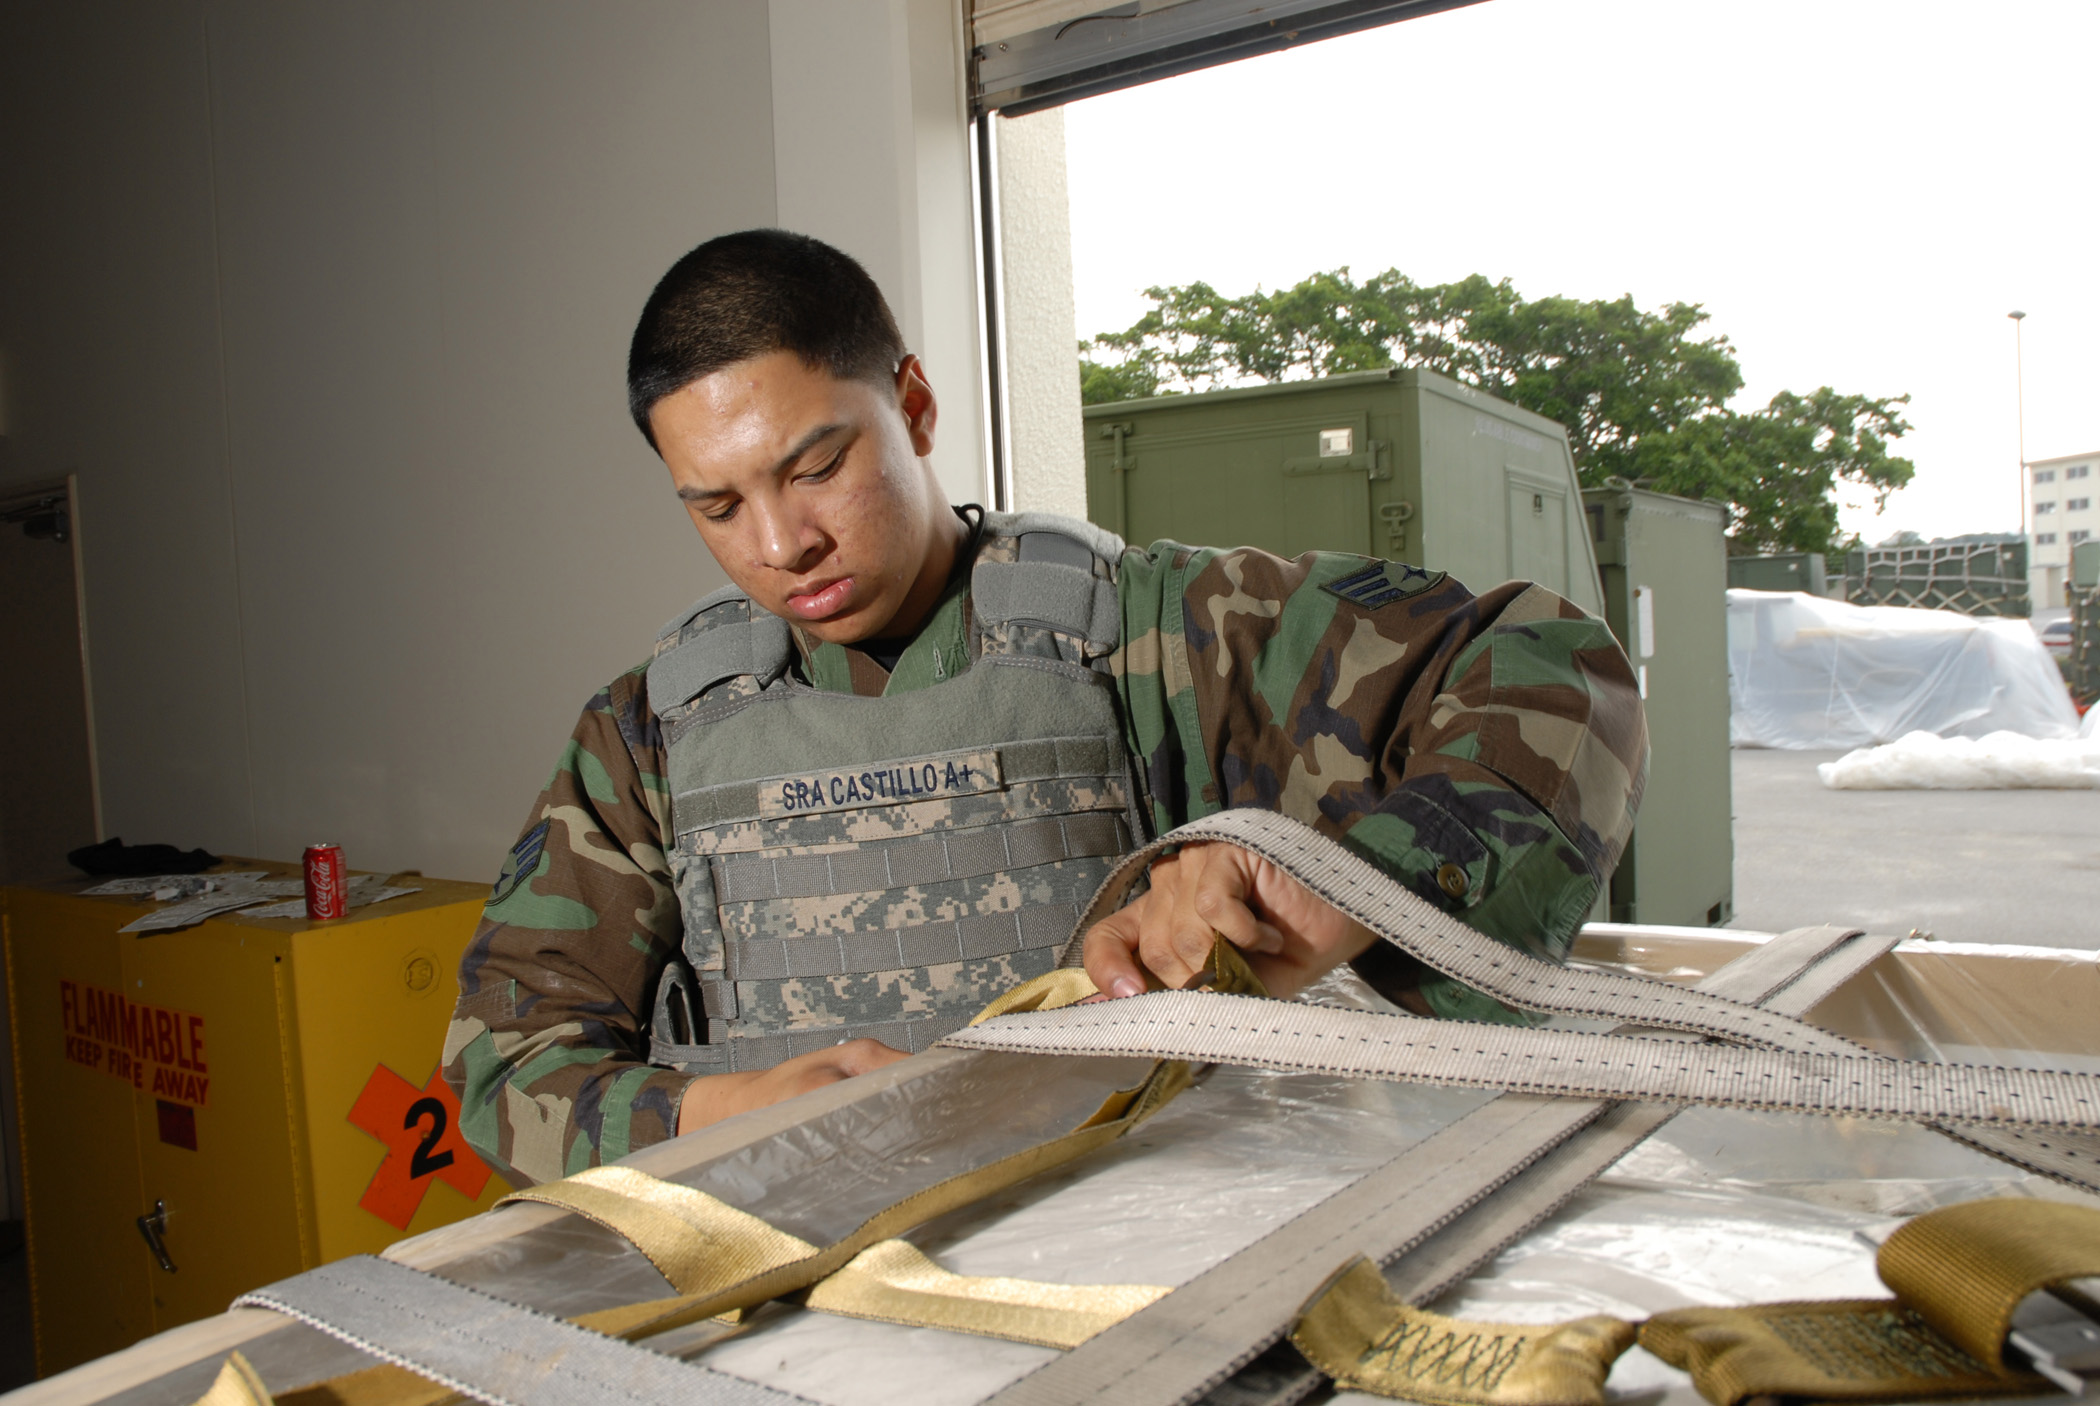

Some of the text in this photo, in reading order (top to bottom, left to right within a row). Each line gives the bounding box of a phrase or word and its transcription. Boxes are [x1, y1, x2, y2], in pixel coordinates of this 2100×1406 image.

[782, 761, 974, 811] SRA CASTILLO A+
[60, 979, 208, 1074] FLAMMABLE
[65, 1033, 209, 1106] KEEP FIRE AWAY
[403, 1096, 454, 1180] 2
